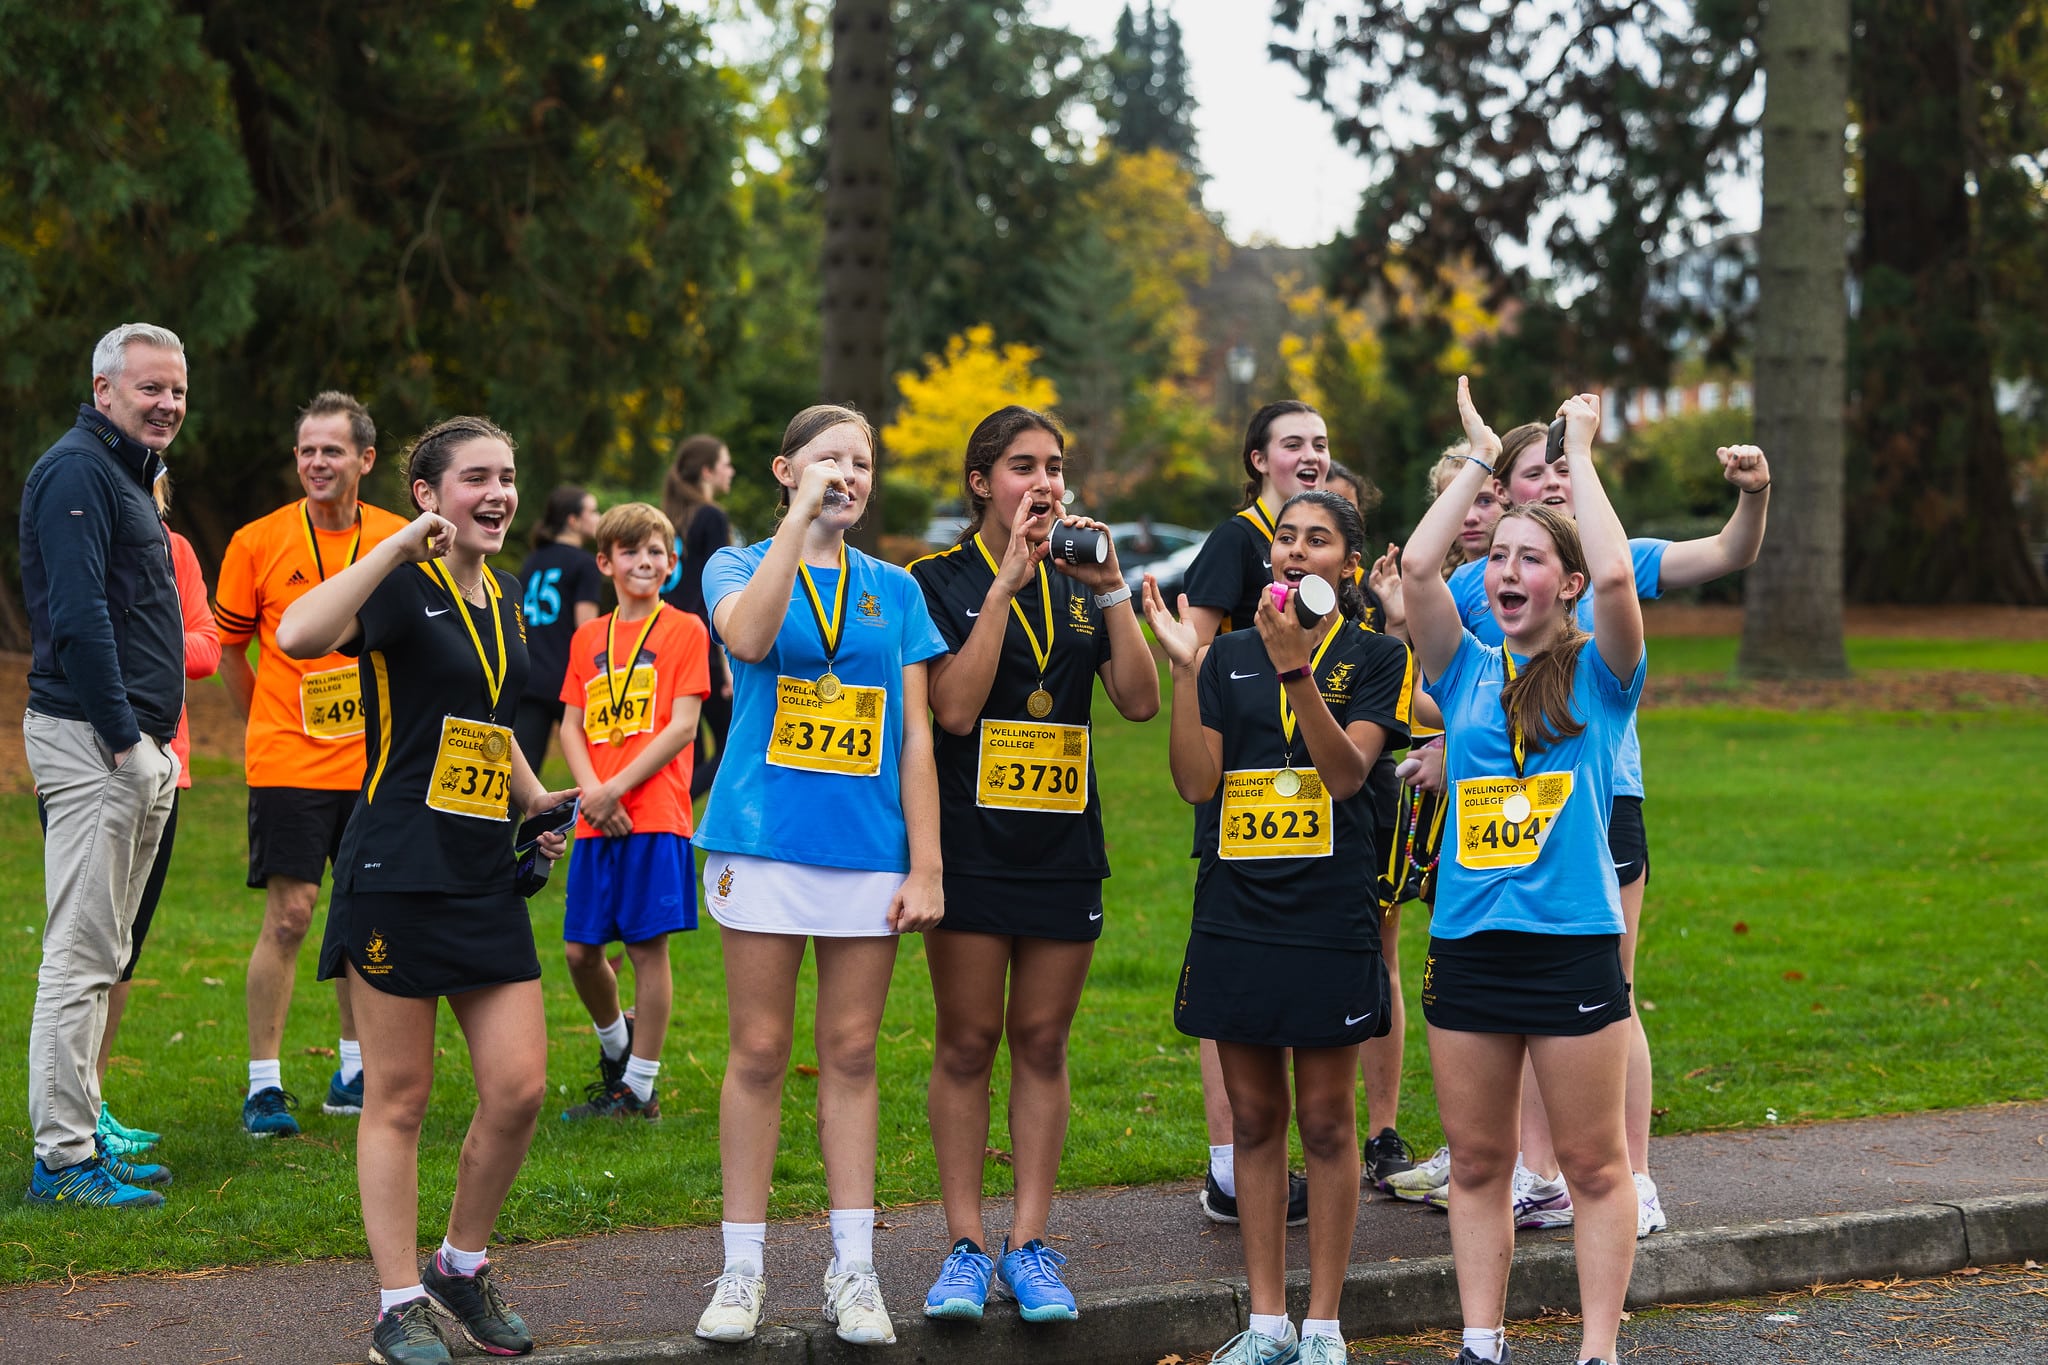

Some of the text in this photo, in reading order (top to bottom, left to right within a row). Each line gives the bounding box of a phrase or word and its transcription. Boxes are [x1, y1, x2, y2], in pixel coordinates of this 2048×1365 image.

[524, 568, 562, 626] 45
[307, 672, 357, 686] WELLINGTON
[307, 683, 342, 695] COLLEGE
[783, 684, 845, 701] WELLINN
[782, 696, 822, 709] COLLEGE
[327, 697, 366, 723] 498
[597, 697, 649, 727] 4987
[451, 726, 486, 739] WELLIN
[796, 721, 872, 757] 3743
[990, 727, 1056, 739] WELLINGTON
[989, 739, 1035, 749] COLLEGE
[1008, 763, 1078, 794] 3730
[1228, 777, 1276, 787] WELLINGTO
[1227, 789, 1264, 798] COLLEGE
[1464, 784, 1527, 795] WELLINGTON
[1465, 797, 1504, 807] COLLEGE
[1242, 810, 1320, 840] 3623
[1482, 817, 1553, 849] 404
